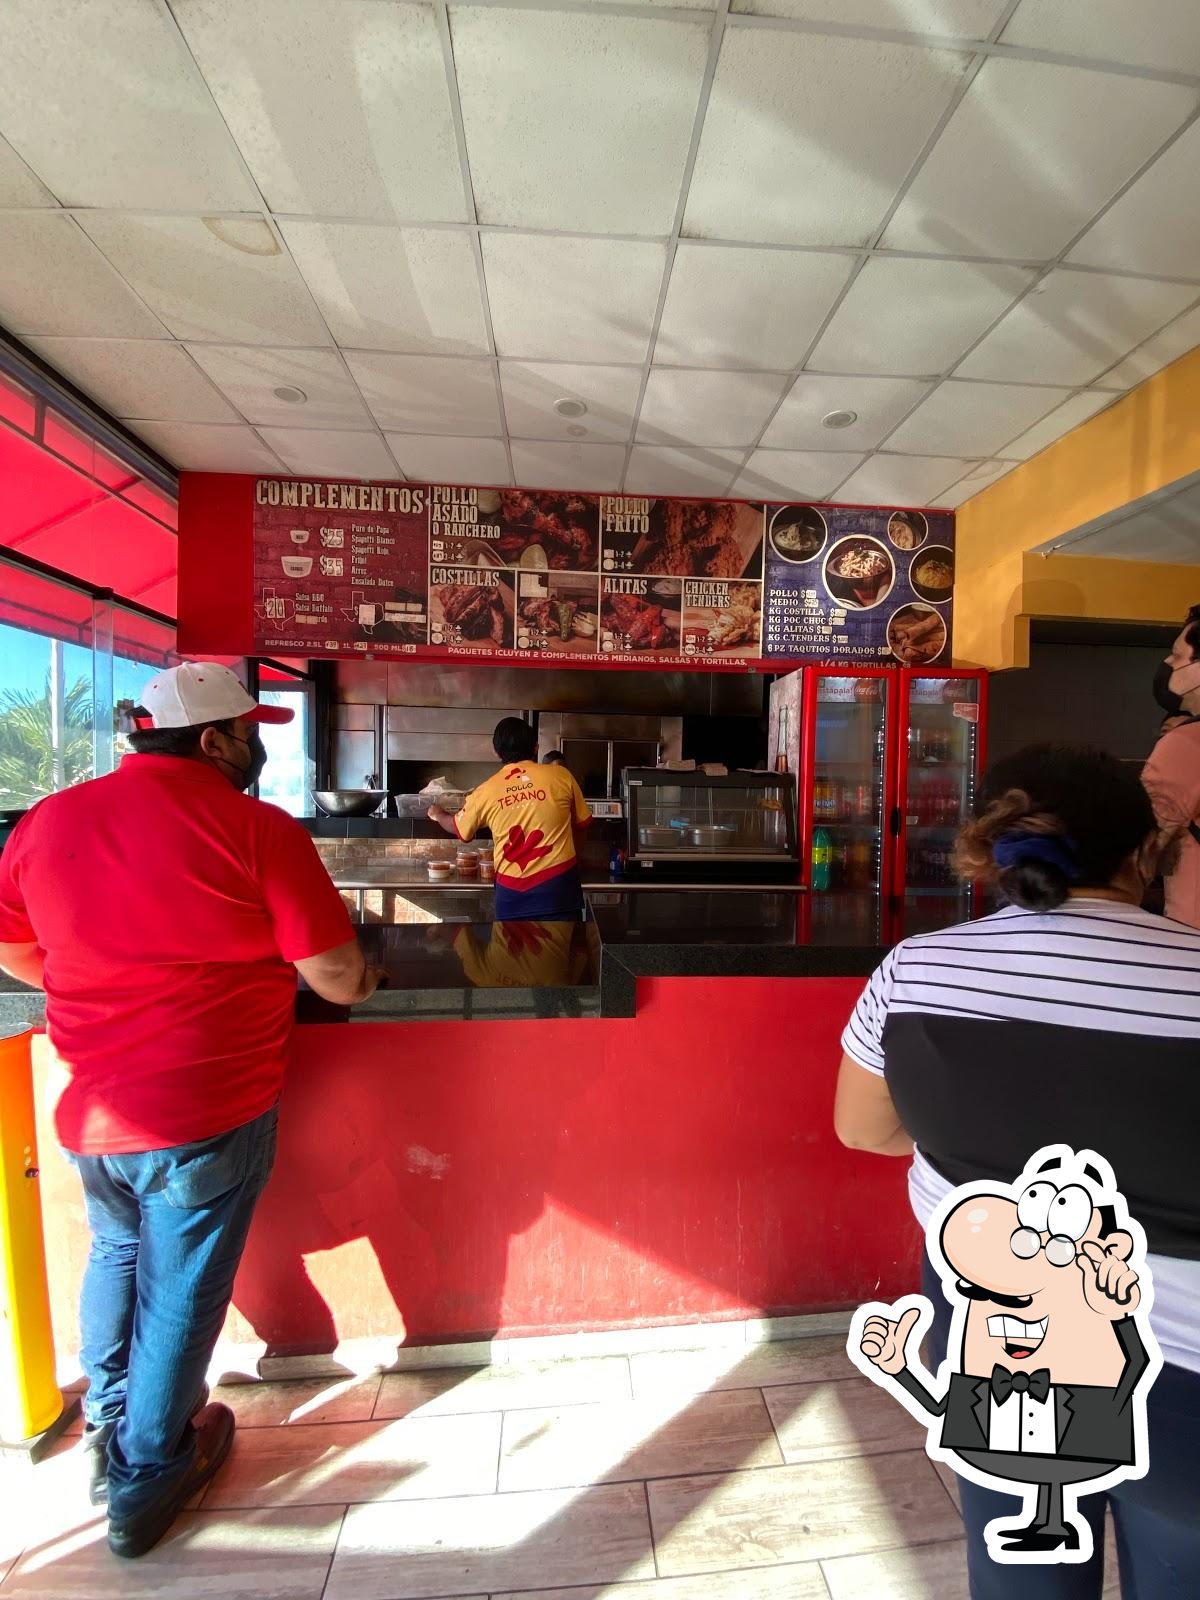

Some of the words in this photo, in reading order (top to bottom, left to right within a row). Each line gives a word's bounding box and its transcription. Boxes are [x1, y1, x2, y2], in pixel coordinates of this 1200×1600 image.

[256, 480, 424, 514] COMPLEMENTOS
[432, 486, 478, 506] POLLO
[606, 496, 649, 515] POLLO
[432, 504, 478, 524] ASADO
[432, 521, 440, 535] O
[444, 523, 500, 539] RANCHERO
[605, 513, 650, 534] FRITO
[432, 568, 500, 587] COSTILLAS
[603, 578, 648, 594] ALITAS
[685, 582, 730, 596] CHICKEN
[769, 589, 799, 597] POLLO
[686, 594, 730, 608] TENDERS
[769, 598, 799, 606] MEDIO
[769, 607, 781, 615] KG
[783, 608, 825, 617] COSTILLA
[768, 616, 781, 625] KG
[783, 616, 801, 625] POC
[803, 617, 827, 626] CHUC
[768, 625, 781, 633] KG
[783, 626, 815, 634] ALITAS
[264, 639, 305, 648] REFRESCO
[768, 633, 781, 642] KG
[783, 634, 830, 643] C.TENDERS
[448, 647, 492, 656] PAQUETES
[495, 650, 531, 658] ICLUYEN
[541, 652, 609, 661] COMPLEMENTOS
[774, 644, 786, 653] PZ
[832, 646, 875, 655] DORADOS
[820, 659, 836, 668] 1/4
[851, 661, 897, 670] TORTILLAS
[506, 782, 534, 793] POLLO
[497, 789, 547, 810] TEXANO
